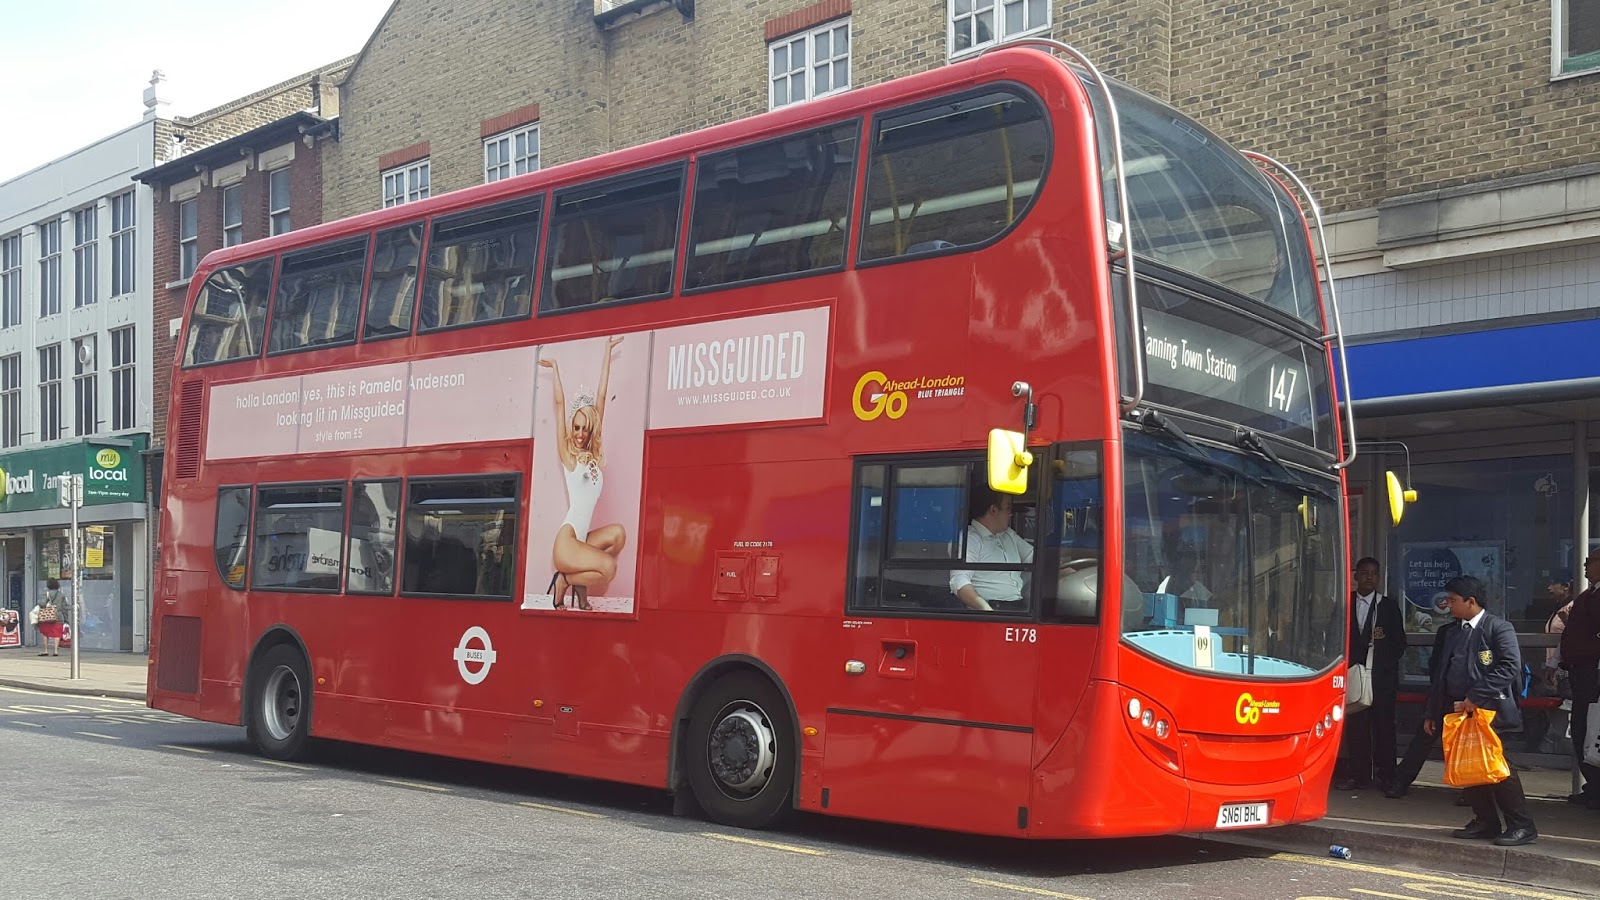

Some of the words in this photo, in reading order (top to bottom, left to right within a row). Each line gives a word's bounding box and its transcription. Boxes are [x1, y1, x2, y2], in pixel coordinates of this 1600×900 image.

[667, 330, 805, 390] MISSGUIDED
[1144, 325, 1177, 369] anning
[1181, 339, 1202, 371] Town
[1205, 348, 1236, 382] Station
[236, 394, 259, 408] holla
[262, 389, 300, 405] London!
[303, 389, 322, 404] yes,
[327, 383, 345, 398] this
[348, 382, 356, 396] is
[359, 377, 402, 395] Pamela
[408, 373, 465, 390] Anderson
[853, 370, 908, 420] Go
[883, 375, 964, 391] Ahead-London
[917, 390, 932, 398] BLUE
[934, 387, 964, 397] TRIANGLE
[1268, 363, 1297, 412] 147
[677, 387, 791, 405] WWW.MISSGUIDED.CO.UK
[276, 410, 312, 427] lookng
[316, 407, 325, 422] lit
[328, 407, 337, 421] in
[341, 400, 405, 422] Missguided
[315, 431, 332, 442] style
[334, 430, 351, 440] from
[353, 428, 362, 438] £5
[101, 453, 116, 465] my
[5, 469, 33, 494] local
[89, 466, 127, 481] local
[1434, 560, 1450, 569] help
[1409, 570, 1422, 579] yo
[1442, 571, 1458, 579] yo
[1409, 579, 1436, 588] perfect
[1438, 580, 1450, 588] IS
[1005, 627, 1036, 642] E178
[1197, 636, 1208, 650] 09
[467, 651, 482, 659] BUSES
[1235, 692, 1259, 724] Go
[1222, 807, 1242, 824] SN61
[1244, 806, 1260, 822] BHL
